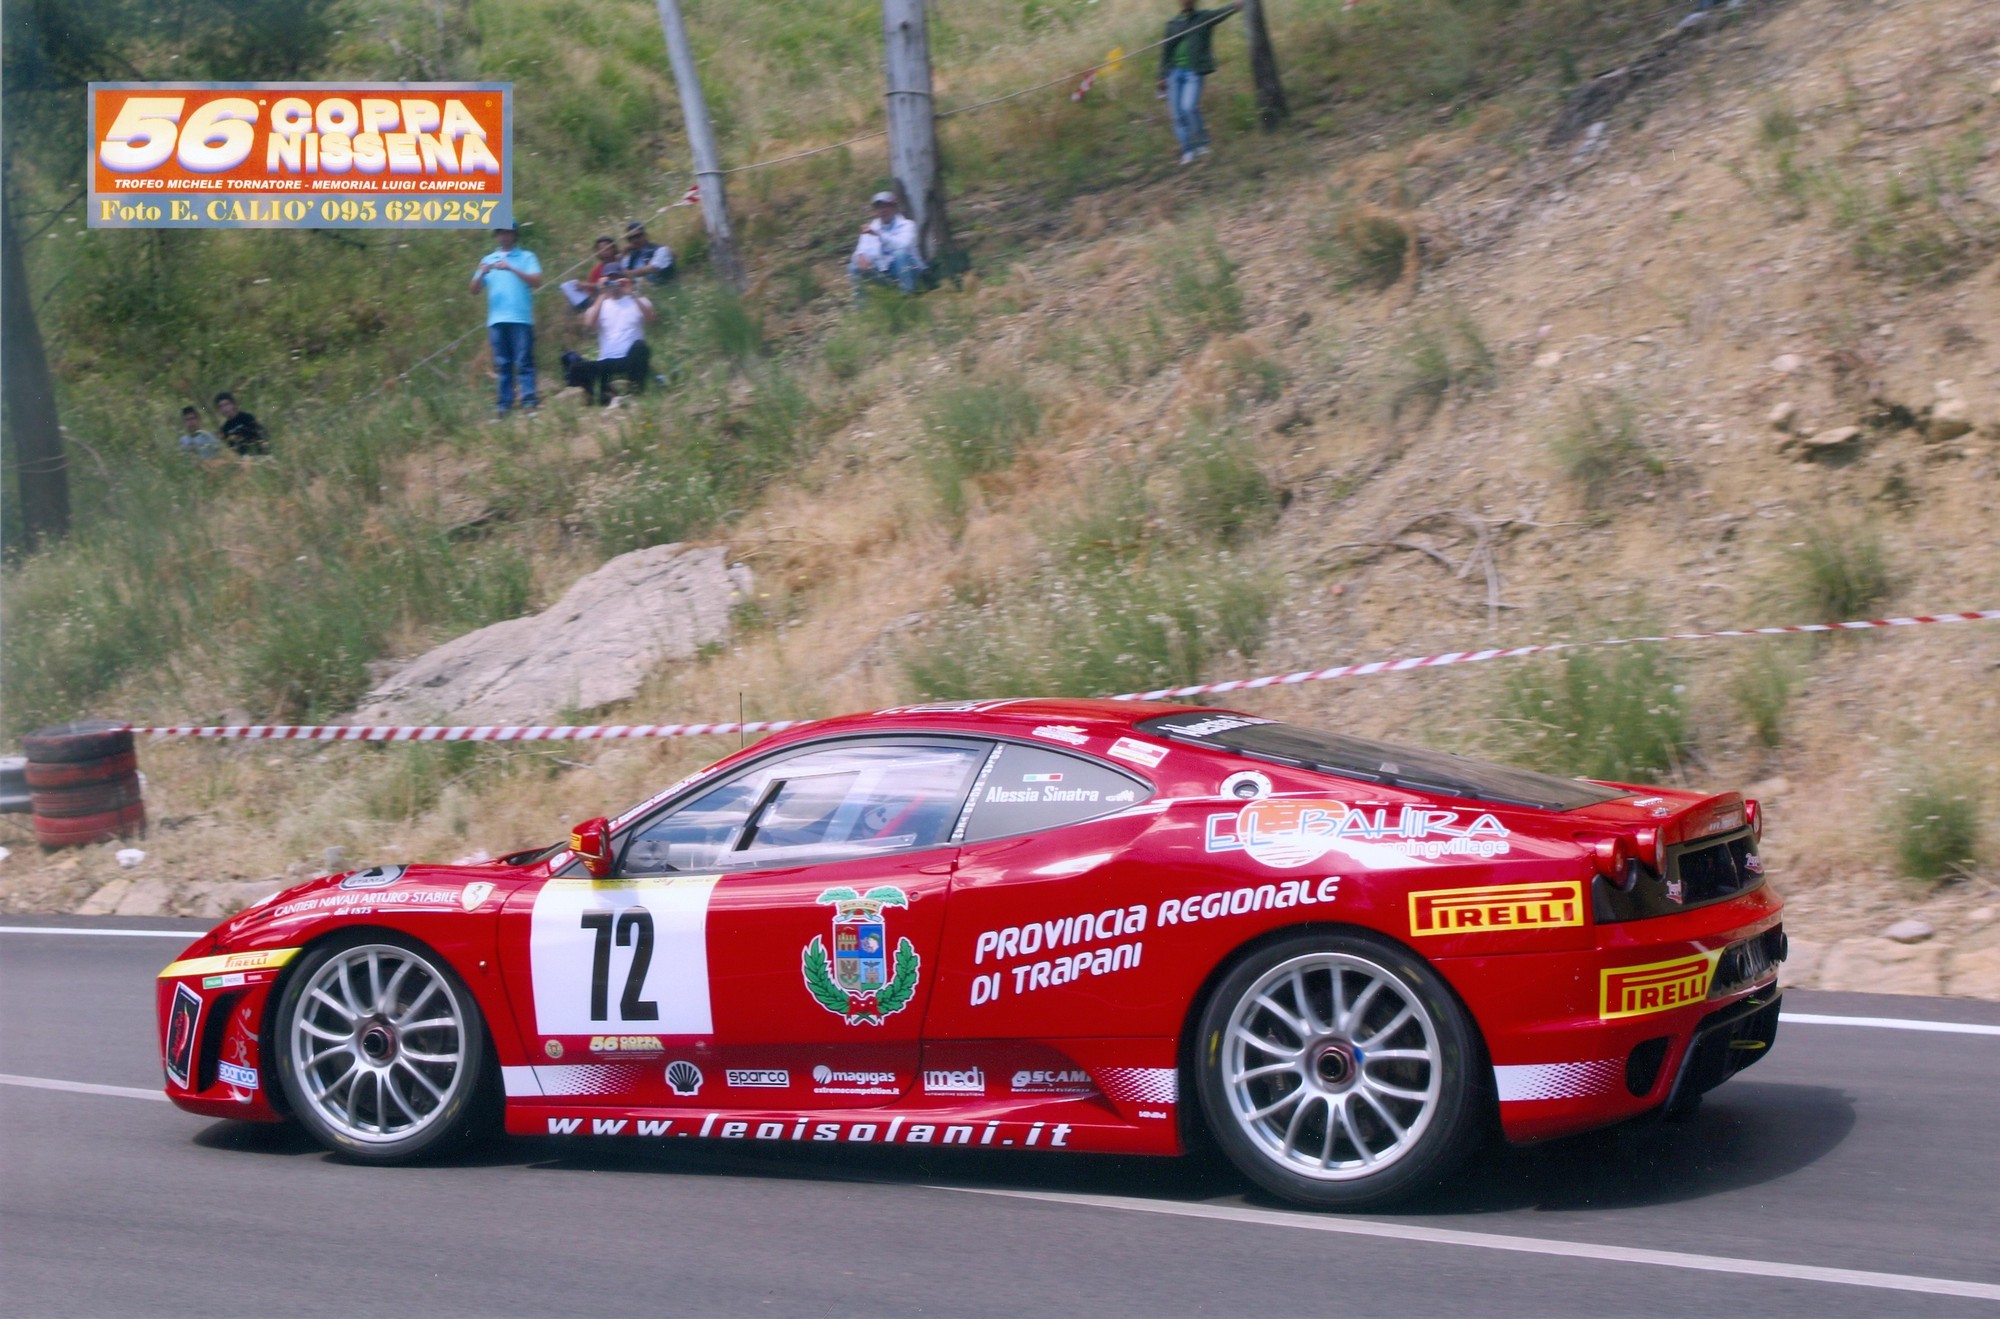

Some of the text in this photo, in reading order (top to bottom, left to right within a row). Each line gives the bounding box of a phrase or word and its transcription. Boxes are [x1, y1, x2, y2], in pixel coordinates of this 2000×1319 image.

[985, 785, 1039, 803] Alessia
[1042, 785, 1099, 803] Sinatra
[1204, 805, 1512, 853] EL BAHIRA
[273, 890, 459, 918] CANTIERI NAVALI ARTURO STABILE
[1414, 886, 1576, 931] PIRELLI
[225, 952, 269, 968] PIRELLI
[580, 905, 659, 1021] 72
[969, 971, 1001, 1007] DI
[1606, 957, 1709, 1014] PIRELLI
[588, 1036, 619, 1052] 56
[219, 1063, 256, 1083] sparco
[728, 1070, 787, 1085] sparco
[832, 1071, 896, 1085] magigas
